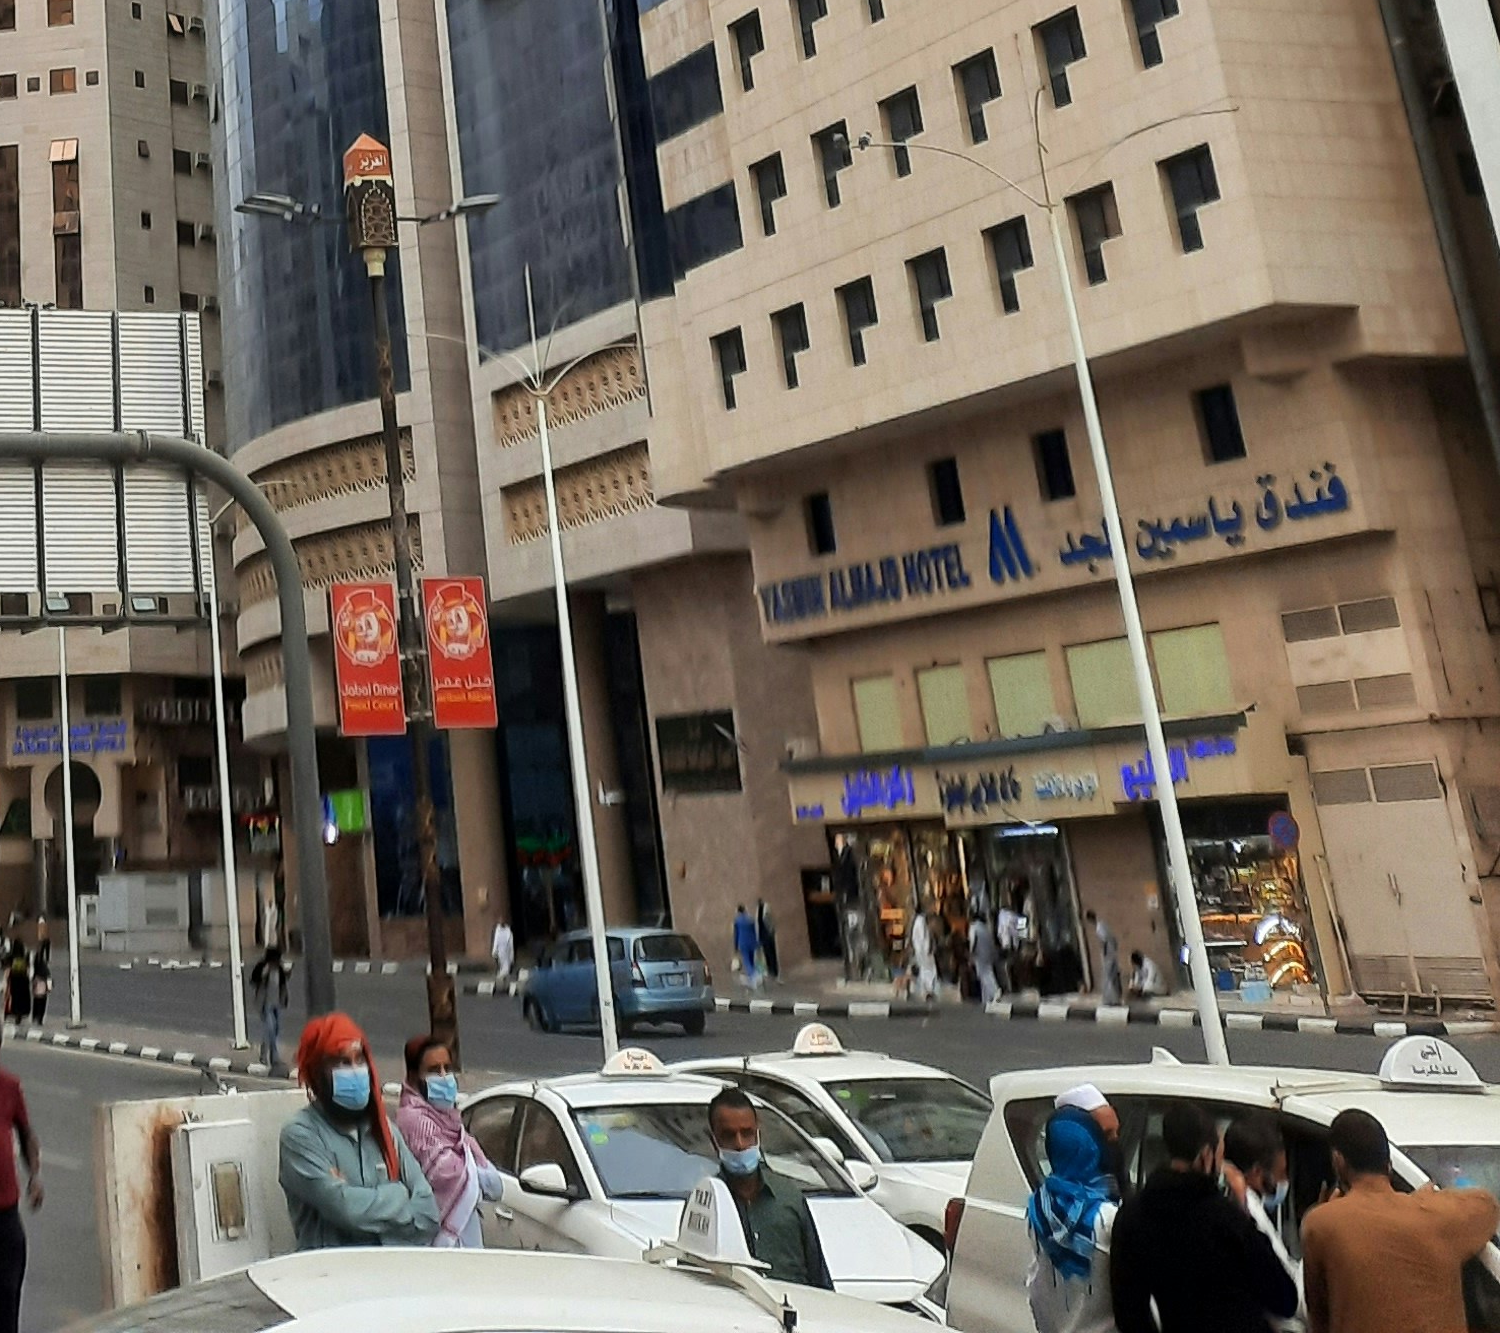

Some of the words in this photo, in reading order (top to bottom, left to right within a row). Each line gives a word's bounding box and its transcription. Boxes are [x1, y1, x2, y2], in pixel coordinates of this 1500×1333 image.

[1256, 461, 1350, 531] فندق
[1135, 496, 1246, 560] ياسمين
[902, 544, 970, 596] HOTEL
[342, 681, 372, 697] Jabal
[373, 682, 399, 697] Omar
